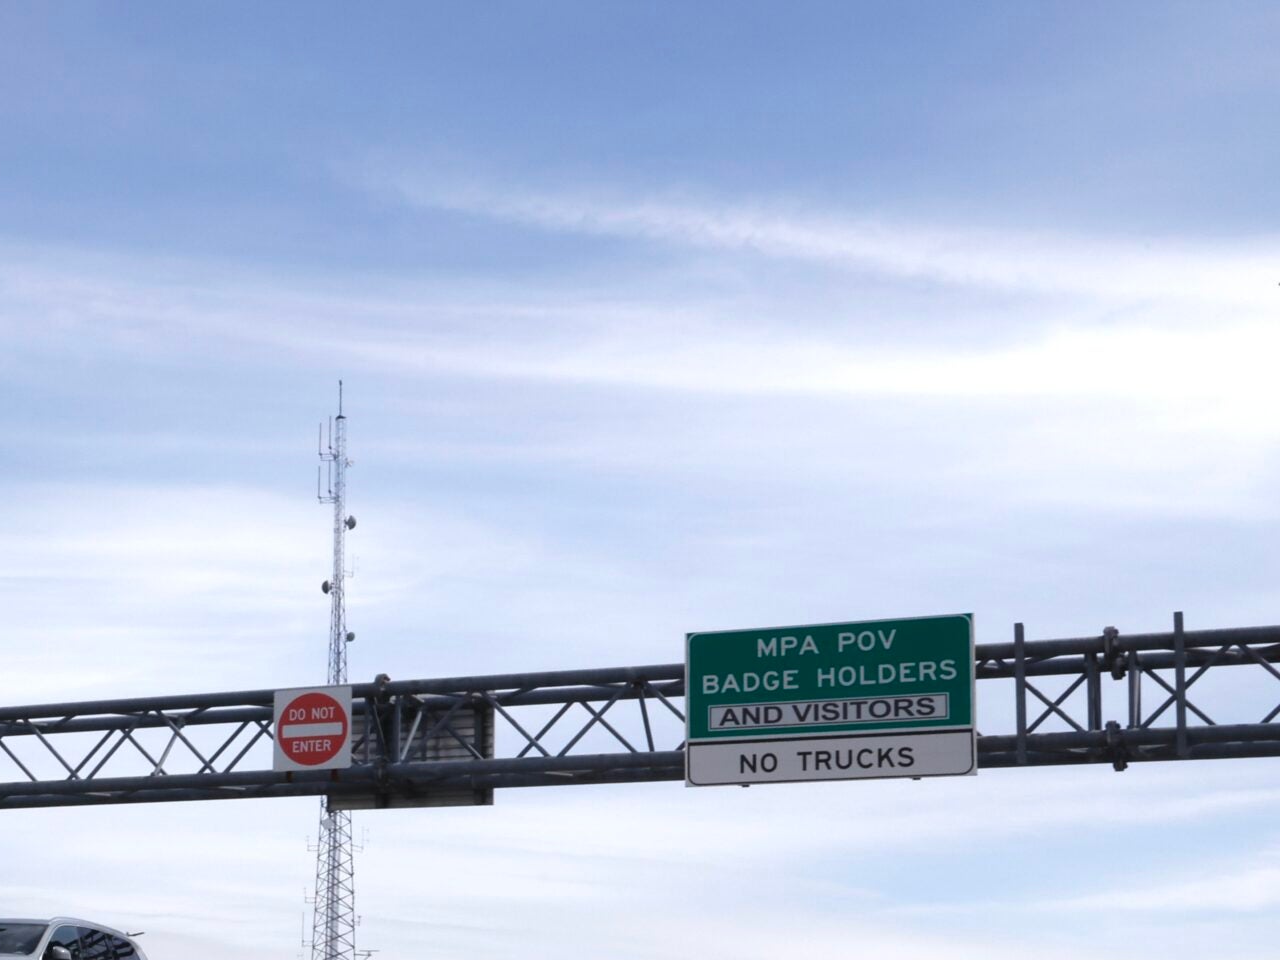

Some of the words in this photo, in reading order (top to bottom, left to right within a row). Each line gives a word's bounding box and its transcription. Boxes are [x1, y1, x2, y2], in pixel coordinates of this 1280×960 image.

[757, 635, 819, 657] MPA
[838, 629, 897, 652] POV
[702, 670, 799, 694] BADGE
[817, 659, 957, 688] HOLDERS
[289, 708, 306, 721] DO
[311, 706, 336, 719] NOT
[719, 706, 783, 726] AND
[791, 697, 936, 722] VISITORS
[292, 739, 331, 753] ENTER
[740, 753, 778, 773] NO
[797, 747, 915, 771] TRUCKS
